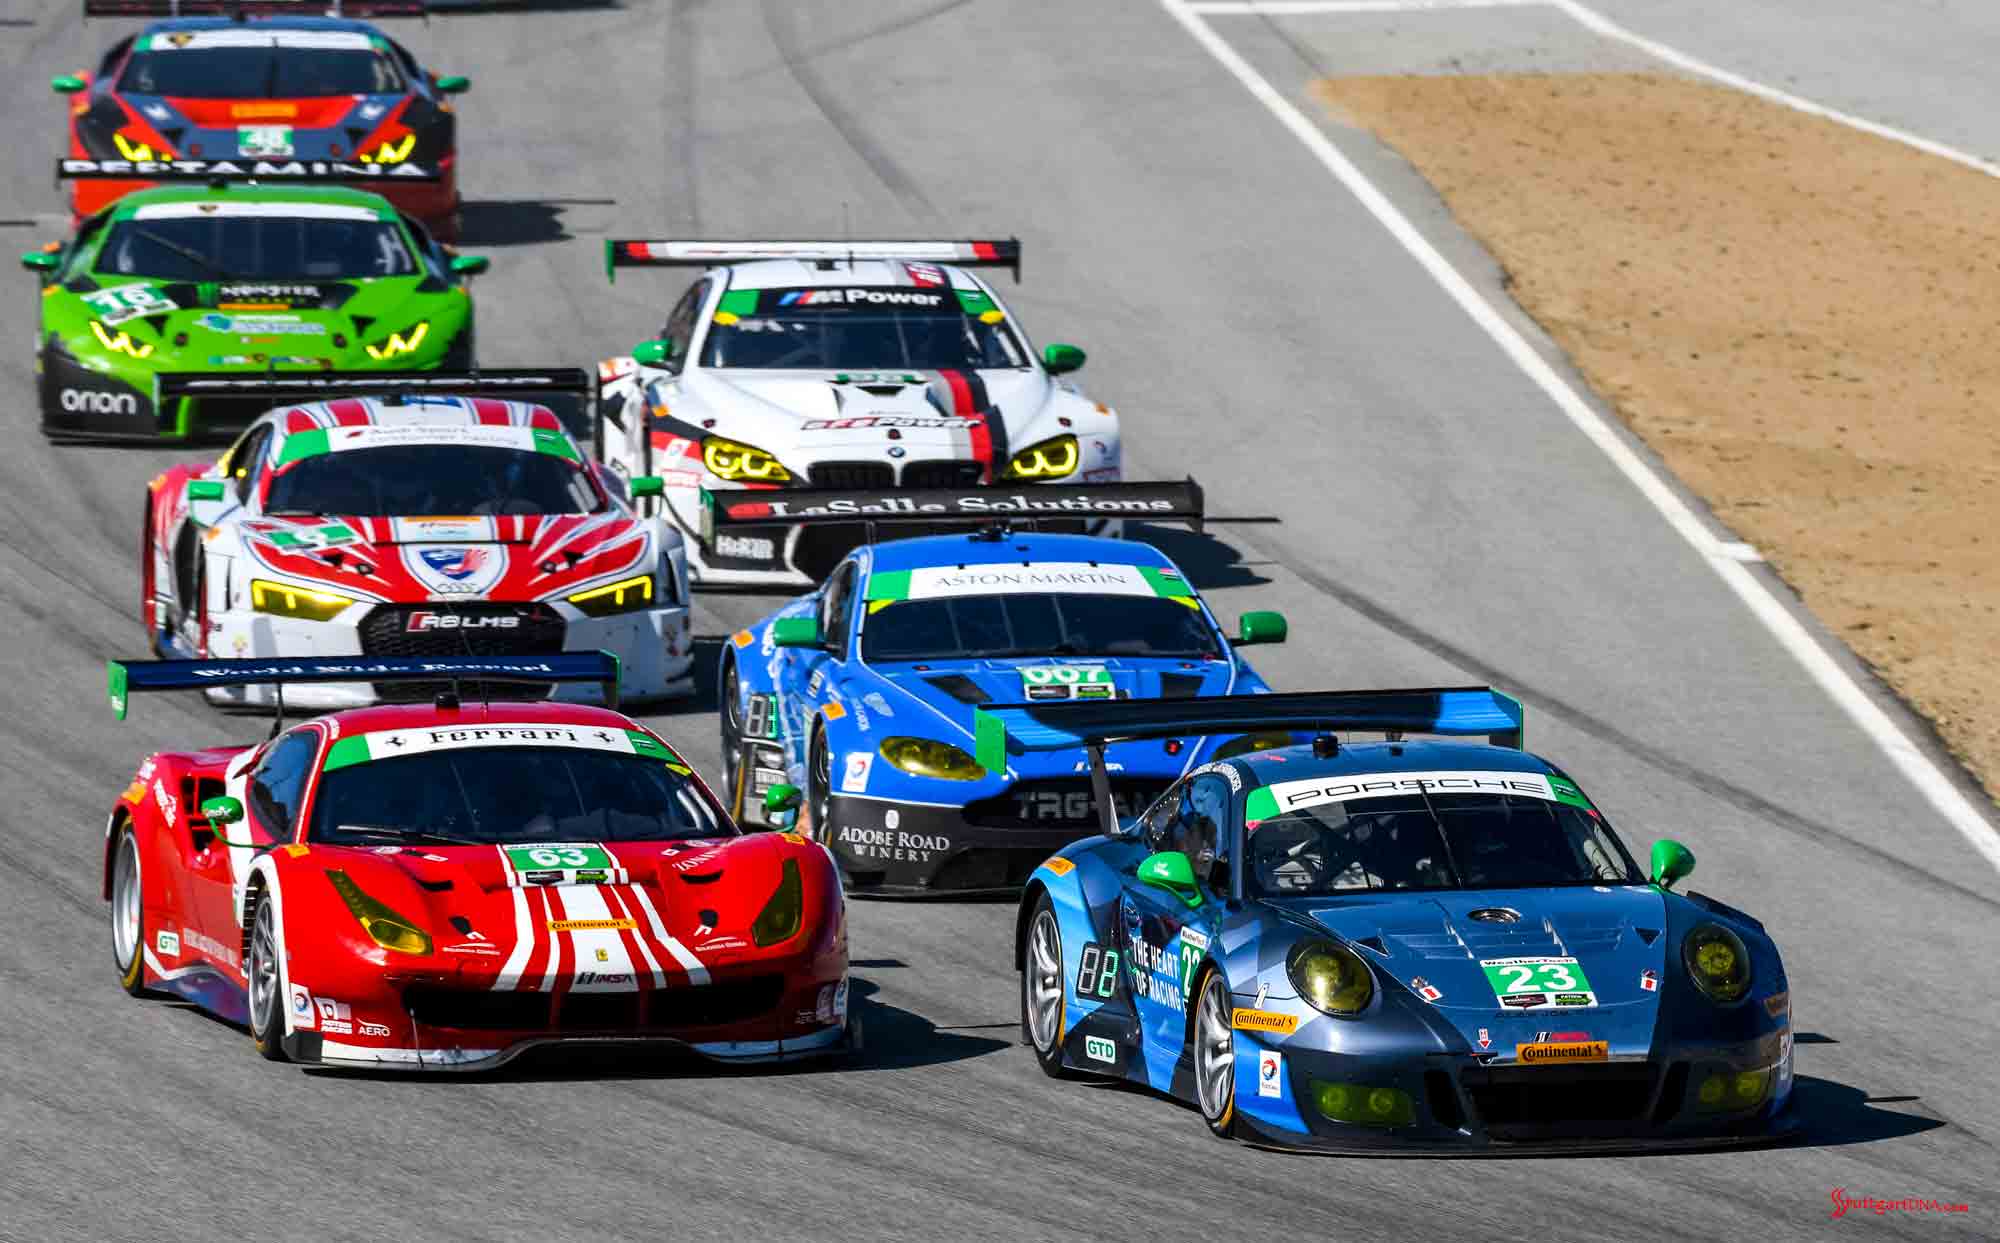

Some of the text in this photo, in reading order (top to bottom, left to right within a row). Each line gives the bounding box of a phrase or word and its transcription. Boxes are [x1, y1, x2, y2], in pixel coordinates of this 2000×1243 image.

[847, 289, 942, 306] Power
[769, 494, 1174, 515] LaSalle Solutions
[935, 570, 1127, 588] ASTON MARTIN
[461, 615, 521, 629] LMS
[428, 728, 578, 744] Ferrari
[1287, 778, 1546, 806] PORSCHE
[838, 826, 951, 851] ADOBE ROAD
[529, 848, 589, 866] 63
[853, 843, 931, 862] WINERY
[1132, 935, 1179, 980] THE HEART
[1498, 964, 1577, 993] 23
[1135, 969, 1182, 1012] OF RACING
[1235, 1010, 1286, 1028] Continental
[1087, 1039, 1115, 1059] GTD
[1521, 1044, 1593, 1062] Continental
